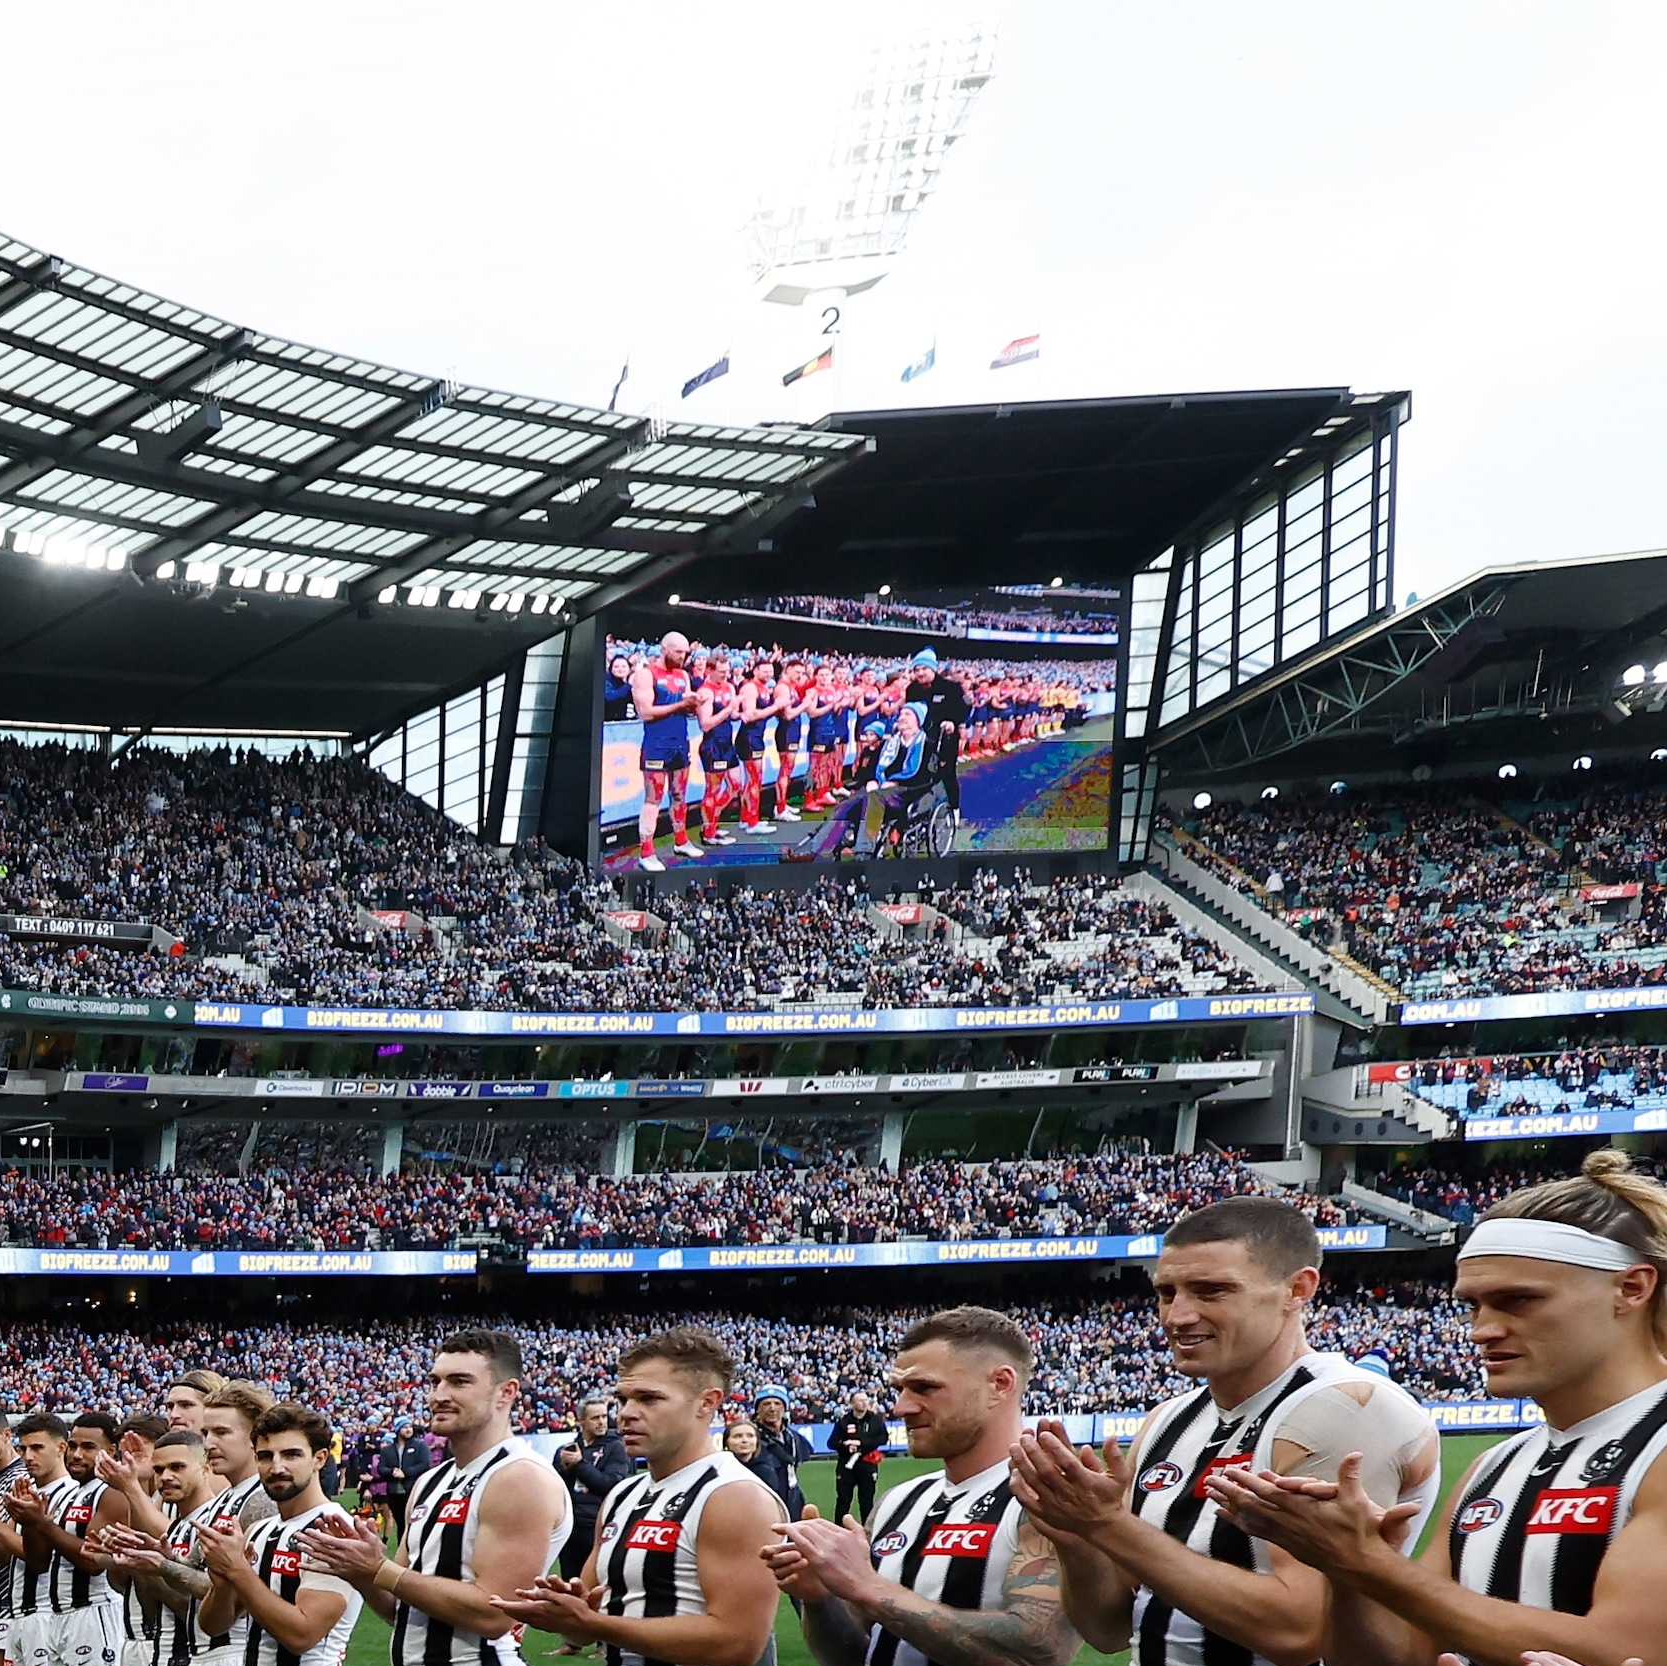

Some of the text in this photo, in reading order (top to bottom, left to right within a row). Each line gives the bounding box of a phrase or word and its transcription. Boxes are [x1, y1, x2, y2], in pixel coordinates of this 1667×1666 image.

[15, 918, 40, 932] TEXT
[50, 921, 74, 934] 0409
[76, 922, 94, 935] 117
[96, 923, 115, 936] 621
[307, 1011, 443, 1029] BIGFREEZE.COM.AU
[512, 1012, 654, 1032] BIGFREEZE.COM.AU
[726, 1012, 877, 1031] BIGFREEZE.COM.AU
[956, 1005, 1120, 1027] BIGFREEZE.COM.AU
[332, 1082, 397, 1096] IDIOM
[492, 1083, 535, 1096] Quayclean
[571, 1083, 616, 1097] OPTUS
[910, 1076, 953, 1090] CyberCX
[709, 1248, 856, 1267] BIGFREEZE.COM.AU
[938, 1239, 1098, 1260] BIGFREEZE.COM.AU
[40, 1252, 170, 1272] BIGFREEZE.COM.AU
[239, 1254, 372, 1272] BIGFREEZE.COM.AU
[1140, 1468, 1179, 1488] AFL
[66, 1507, 90, 1519] KFC
[1461, 1506, 1498, 1530] AFL
[1526, 1495, 1606, 1526] KFC
[630, 1526, 673, 1546] KFC
[875, 1535, 905, 1552] AFL
[925, 1530, 987, 1550] KFC
[271, 1554, 297, 1572] KFC
